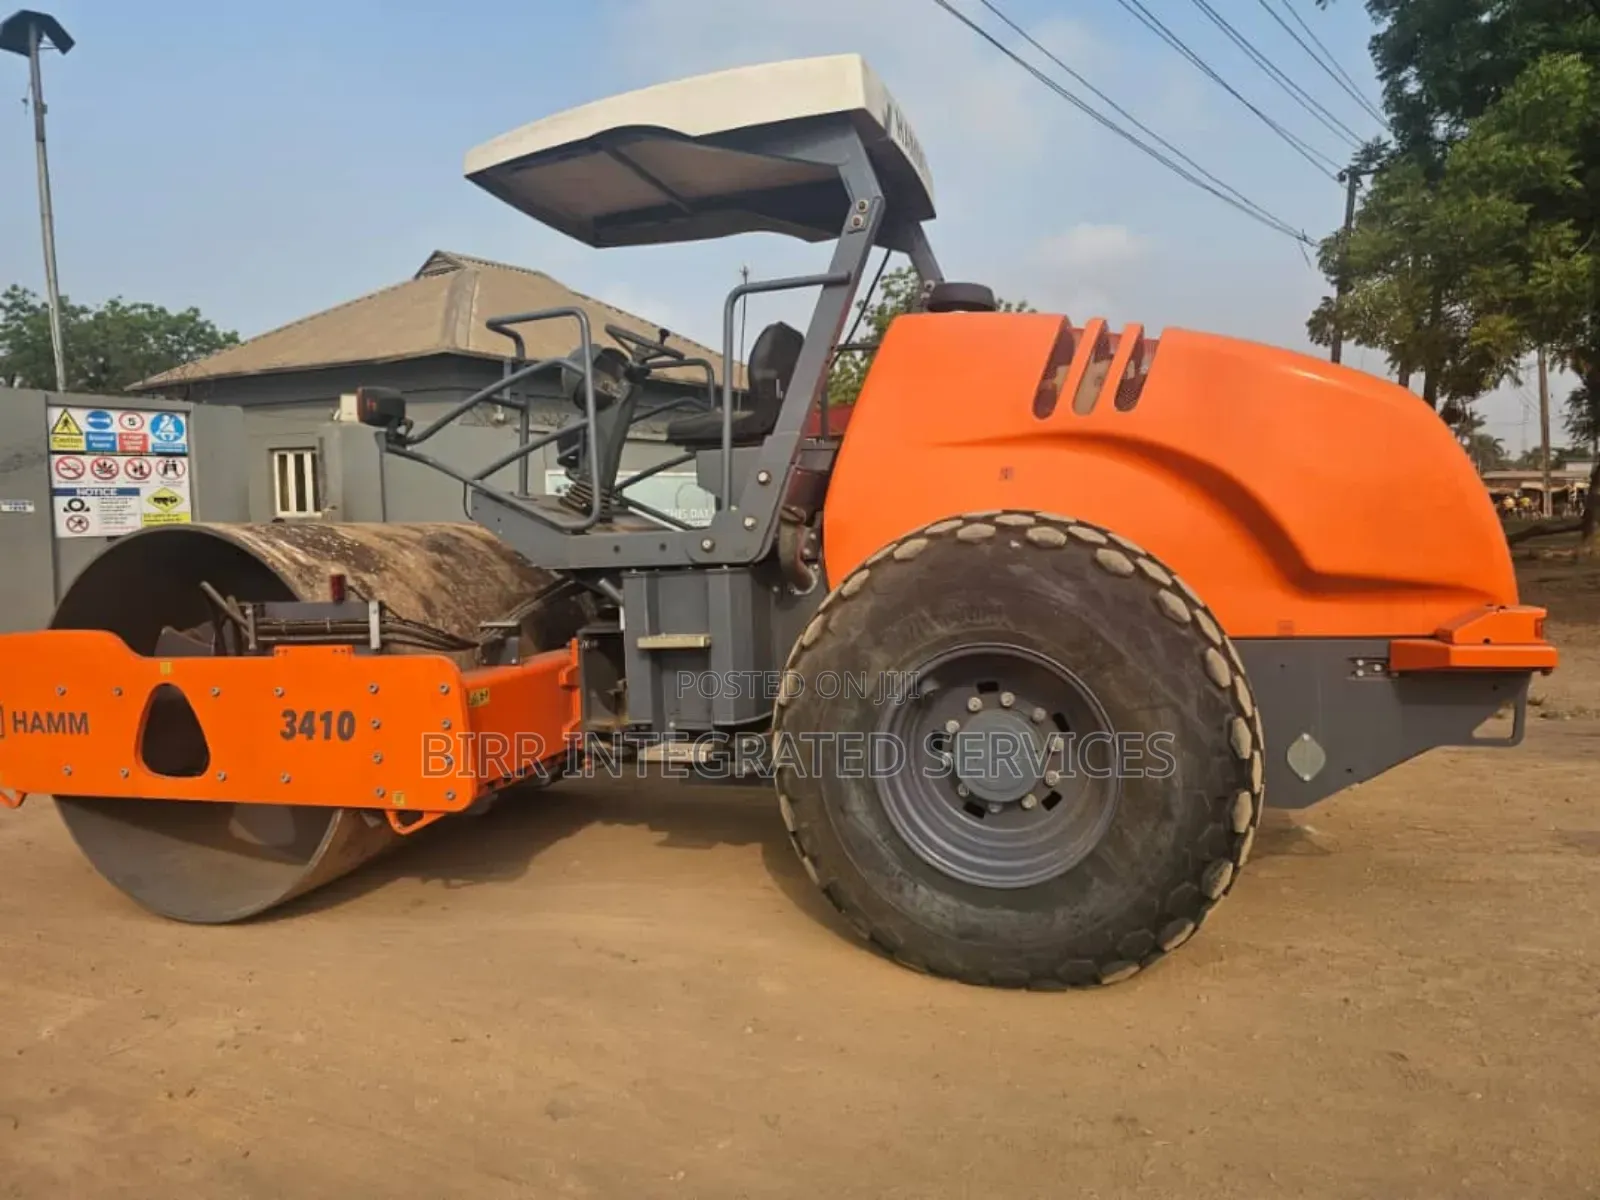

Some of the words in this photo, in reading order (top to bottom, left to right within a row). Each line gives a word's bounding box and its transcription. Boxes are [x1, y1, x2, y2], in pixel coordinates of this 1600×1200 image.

[77, 487, 118, 496] NOTICE
[12, 710, 89, 736] HAMM
[279, 708, 357, 742] 3410
